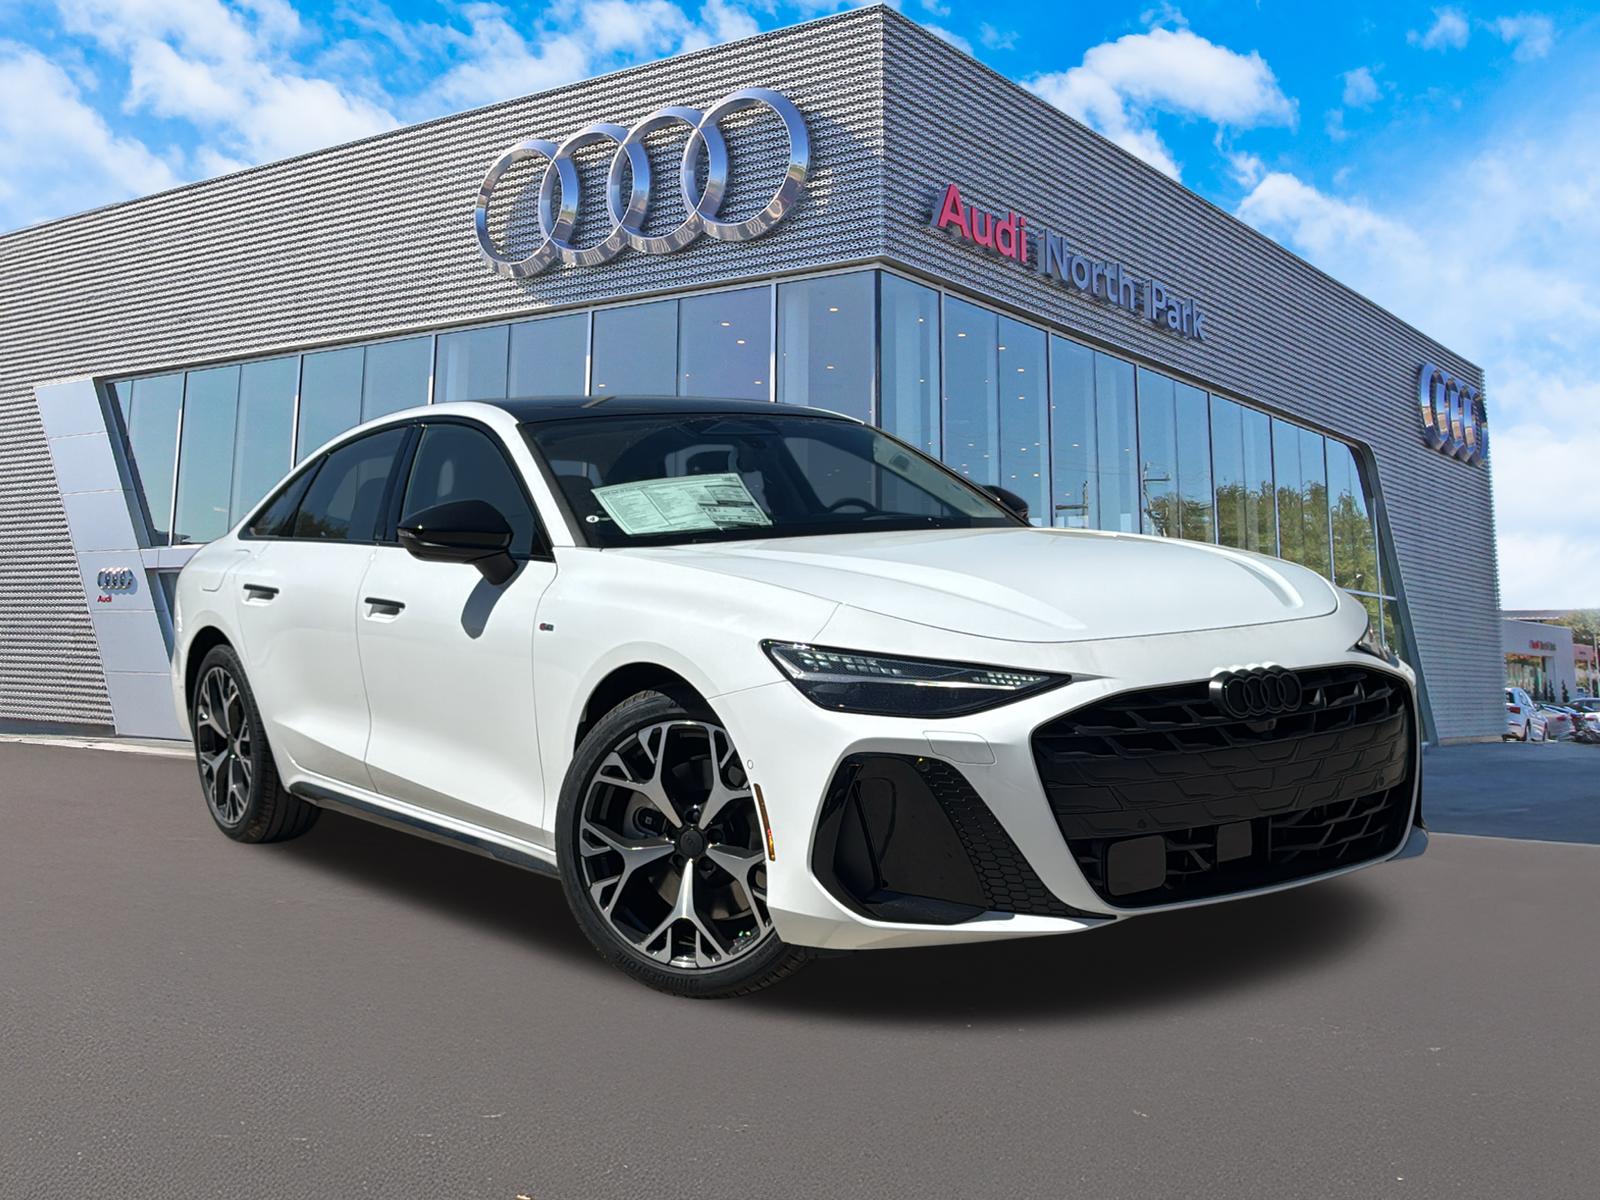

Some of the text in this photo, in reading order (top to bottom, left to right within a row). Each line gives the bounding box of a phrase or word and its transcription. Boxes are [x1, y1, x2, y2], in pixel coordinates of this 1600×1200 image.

[936, 184, 1207, 341] Audi North Park
